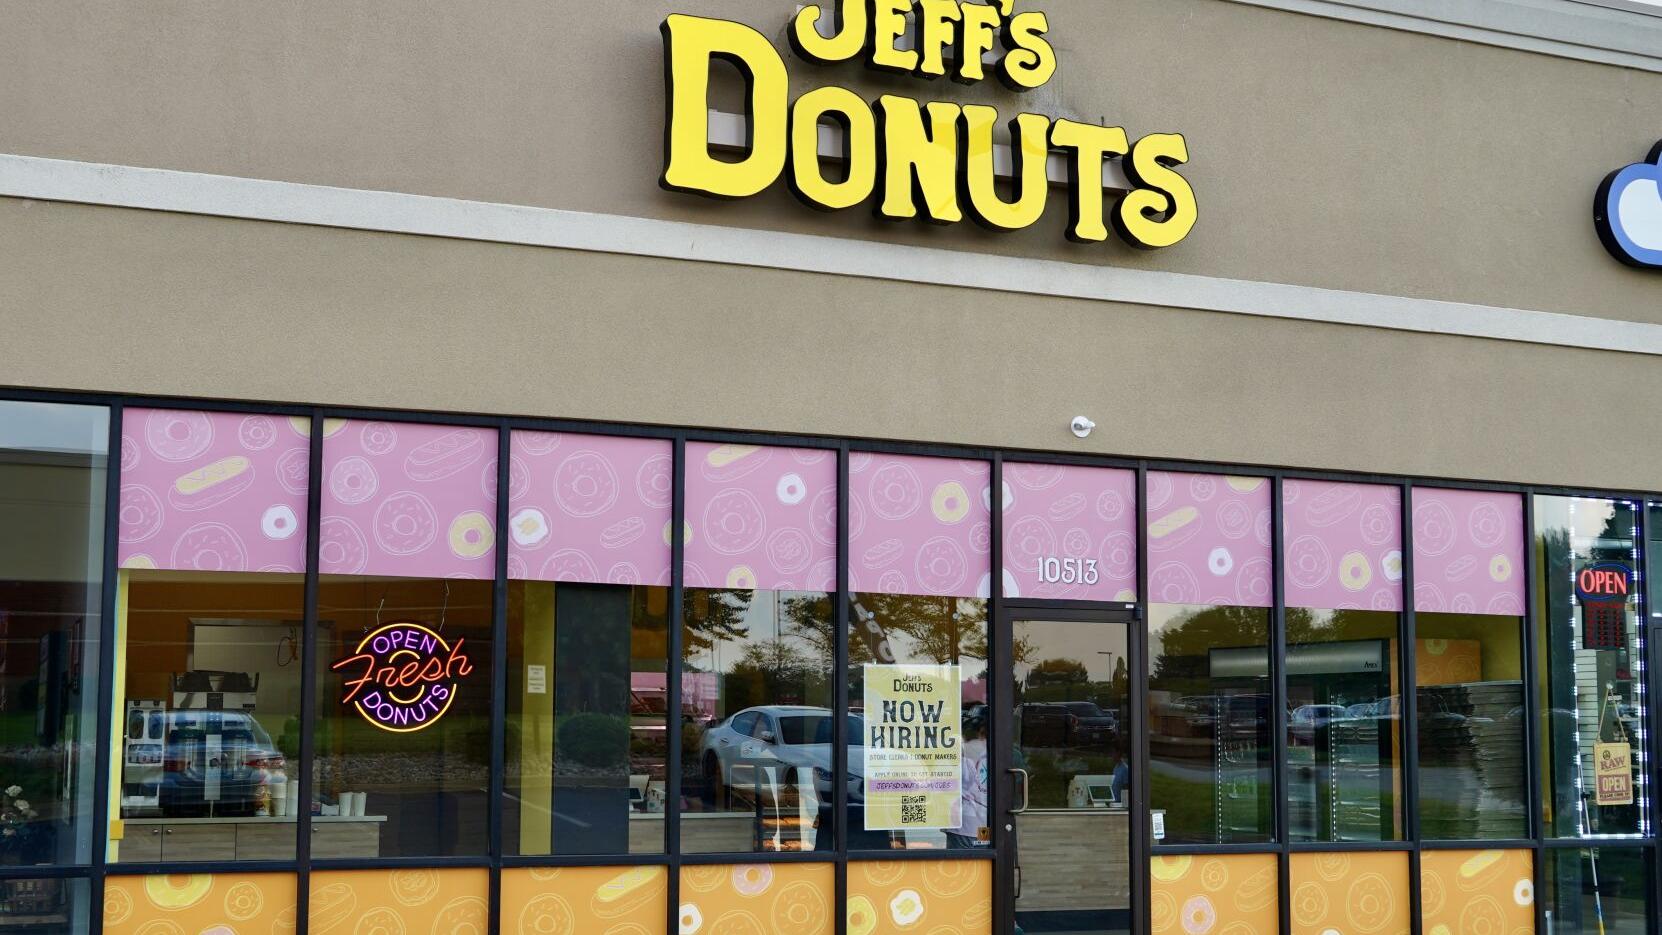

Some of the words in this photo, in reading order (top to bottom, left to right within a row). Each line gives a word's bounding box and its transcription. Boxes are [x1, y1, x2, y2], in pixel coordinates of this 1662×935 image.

[792, 0, 1058, 90] JEFF'S
[661, 13, 1199, 249] DONUTS
[1038, 556, 1099, 585] 10513
[1580, 569, 1627, 594] OPEN
[373, 630, 437, 655] OPEN
[332, 638, 473, 704] Fresh
[893, 679, 933, 693] DONUTS
[363, 684, 449, 726] DONUTS
[882, 700, 944, 723] NOW
[871, 726, 956, 749] HIRING
[915, 753, 933, 761] DONUT
[1600, 755, 1626, 770] RAW
[1602, 776, 1627, 792] OPEN
